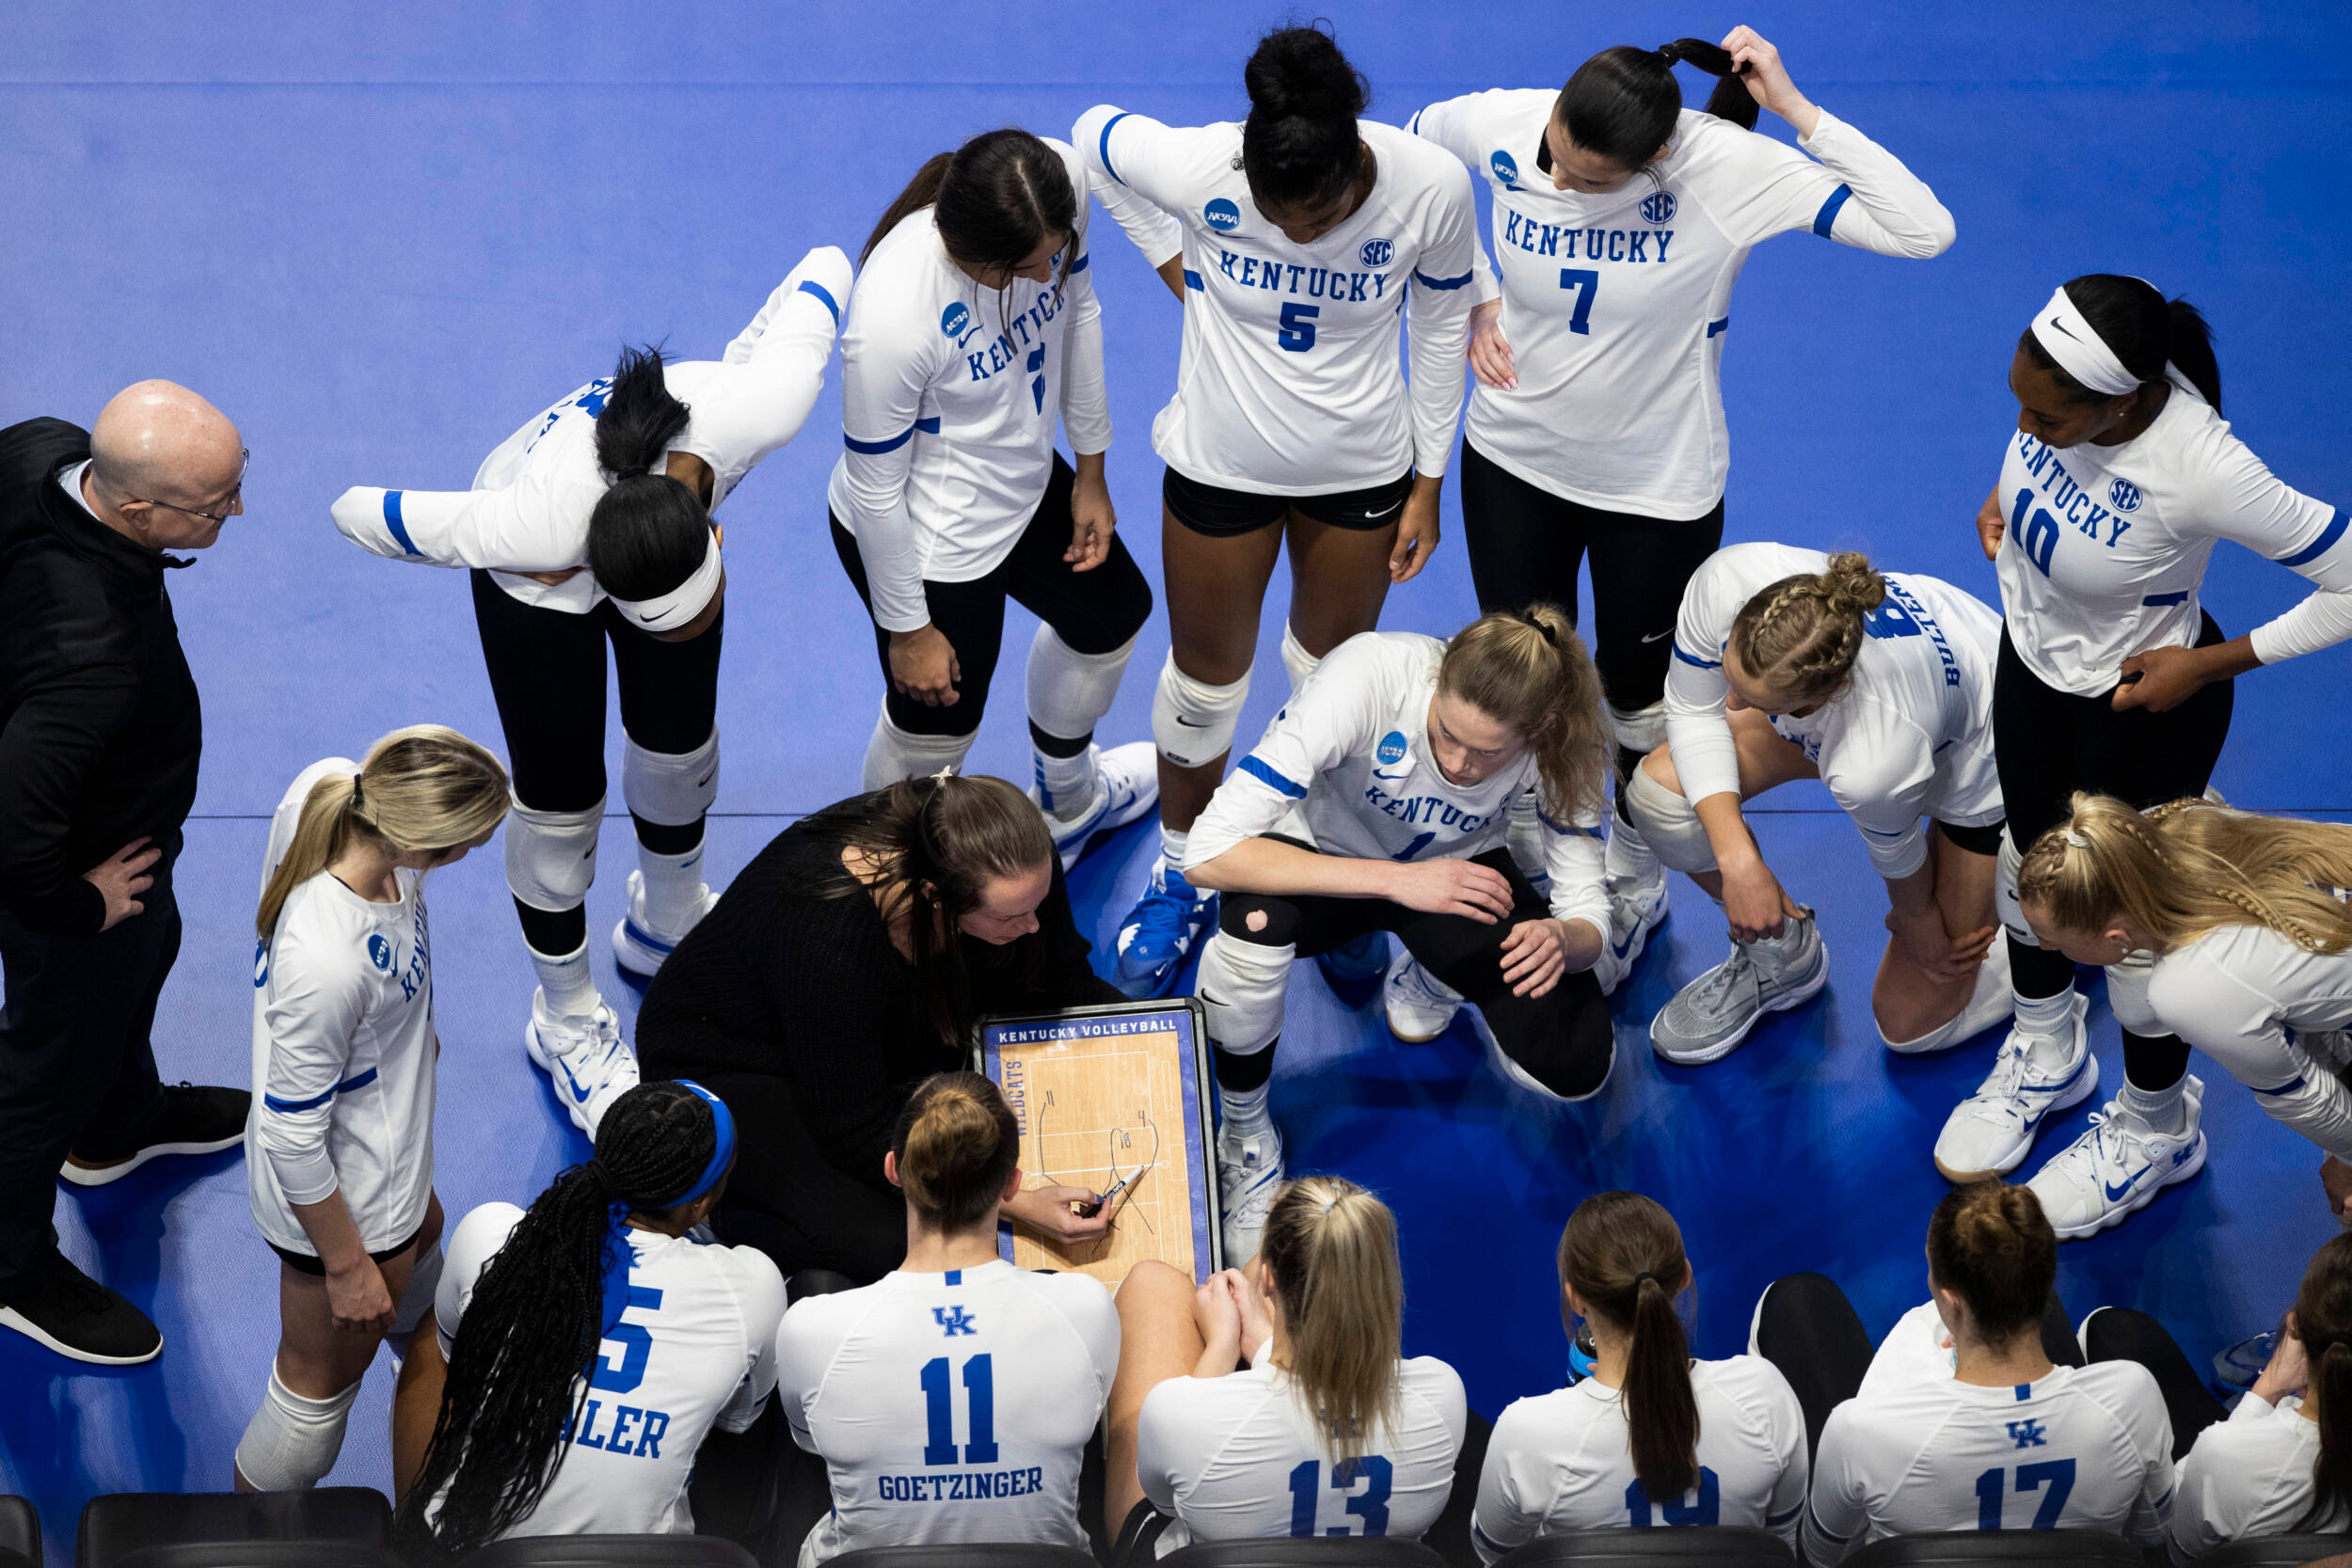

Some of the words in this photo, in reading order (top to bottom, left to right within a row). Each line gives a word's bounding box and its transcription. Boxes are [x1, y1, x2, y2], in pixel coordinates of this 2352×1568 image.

[1494, 161, 1518, 181] NCAA
[1208, 210, 1240, 225] NCAA
[1642, 192, 1674, 223] SEC
[1362, 240, 1391, 265] SEC
[1505, 210, 1674, 263] KENTUCKY
[1219, 249, 1389, 301] KENTUCKY
[1278, 301, 1320, 352] 5
[1559, 268, 1599, 336] 7
[967, 284, 1066, 381] KENTCK
[2018, 432, 2131, 548] ENTUCKY
[2110, 479, 2142, 511] SEC
[2011, 487, 2059, 578] 10
[1883, 575, 1961, 689] BULTEM
[998, 1026, 1076, 1044] KENTUCKY
[1082, 1019, 1177, 1037] VOLLEYBALL
[930, 1305, 977, 1338] UK
[920, 1353, 998, 1466] 11
[2005, 1418, 2047, 1450] UK
[878, 1465, 1043, 1501] GOETZINGER
[1289, 1454, 1393, 1538] 13
[1975, 1457, 2076, 1529] 17
